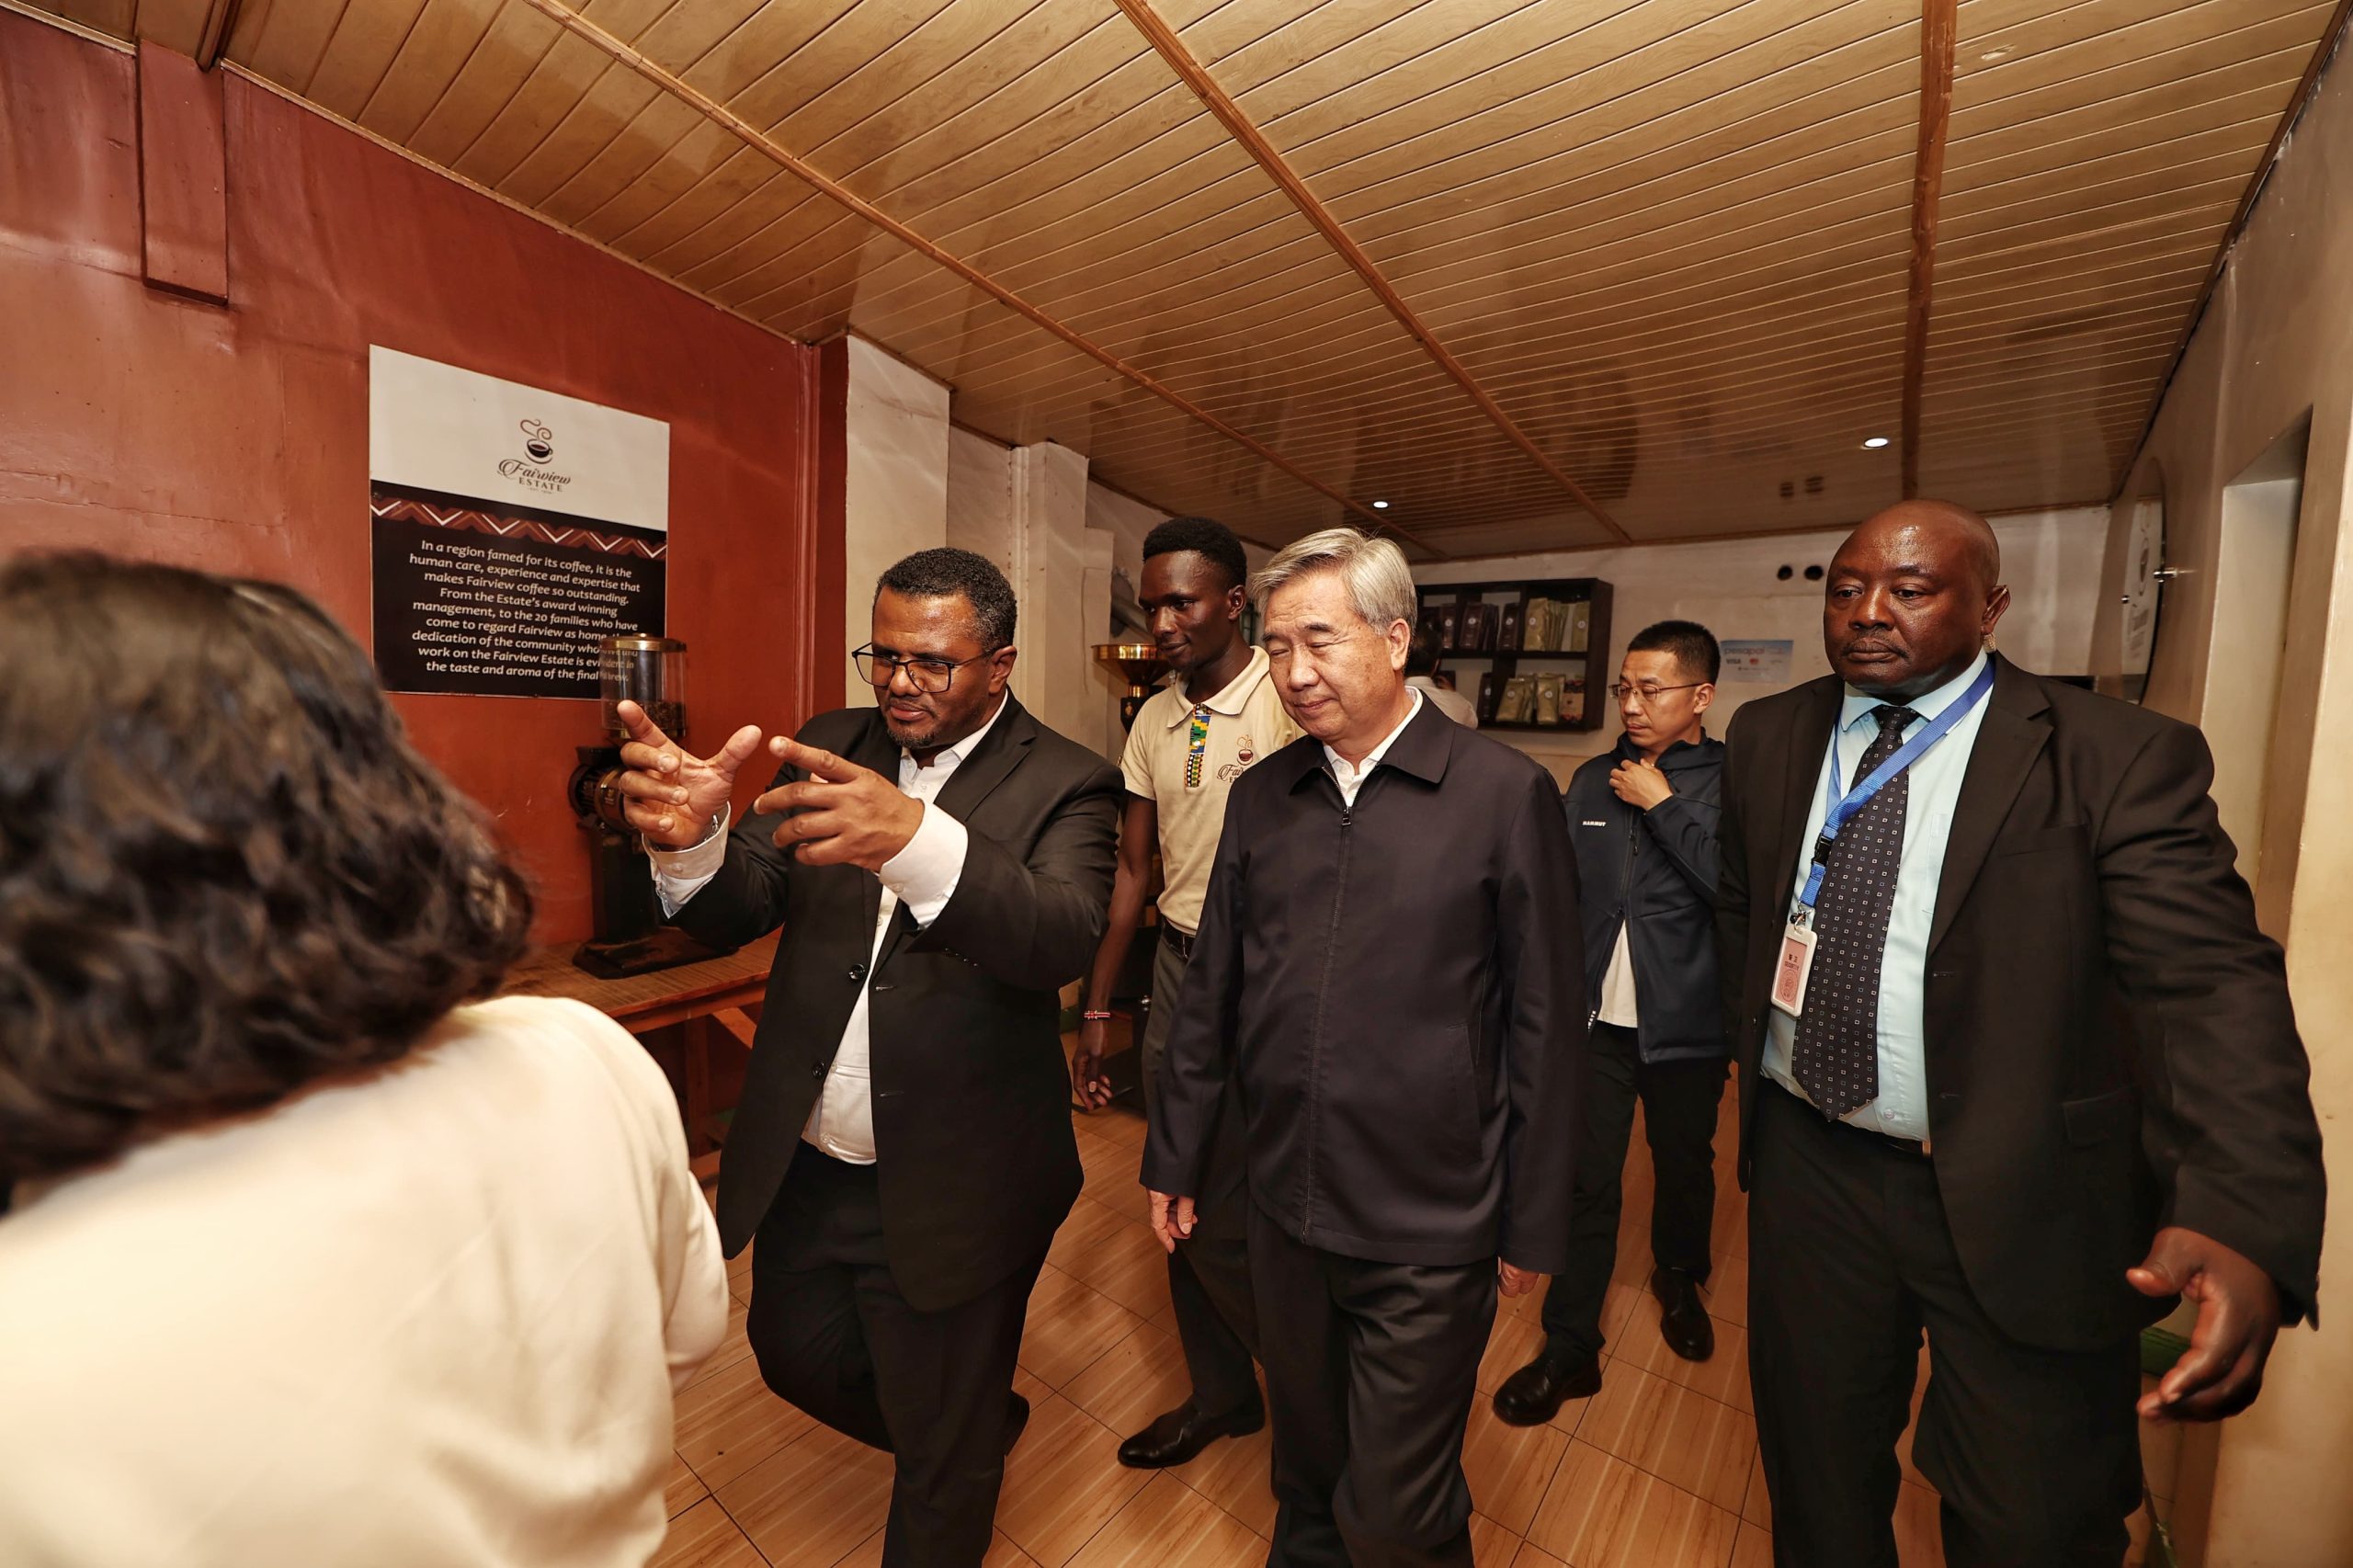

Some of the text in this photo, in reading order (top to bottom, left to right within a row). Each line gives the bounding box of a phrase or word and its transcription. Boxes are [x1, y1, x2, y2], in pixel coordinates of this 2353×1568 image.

[497, 459, 571, 484] Fairview
[518, 477, 563, 492] ESTATE
[421, 540, 632, 578] In a region famed for its coffee, it is the
[409, 553, 641, 593] human care, experience and expertise that
[424, 572, 629, 606] makes Fairview coffee so outstanding.
[439, 587, 618, 619] From the Estate’s award winning
[413, 601, 639, 631] management, to the 20 families who have
[426, 618, 460, 629] come
[462, 619, 476, 631] to
[478, 623, 517, 634] regard
[518, 625, 563, 638] Fairview
[564, 631, 576, 639] as
[412, 631, 476, 644] dedication
[478, 635, 493, 647] of
[494, 636, 513, 647] the
[515, 640, 575, 654] community
[577, 643, 599, 654] who
[418, 647, 450, 657] work
[452, 649, 469, 658] on
[471, 649, 491, 660] the
[493, 651, 539, 664] Fairview
[540, 654, 574, 665] Estate
[575, 656, 585, 666] is
[426, 661, 448, 671] the
[449, 663, 480, 674] taste
[482, 665, 505, 675] and
[506, 667, 541, 676] aroma
[543, 667, 557, 679] of
[557, 669, 575, 679] the
[576, 669, 599, 682] final
